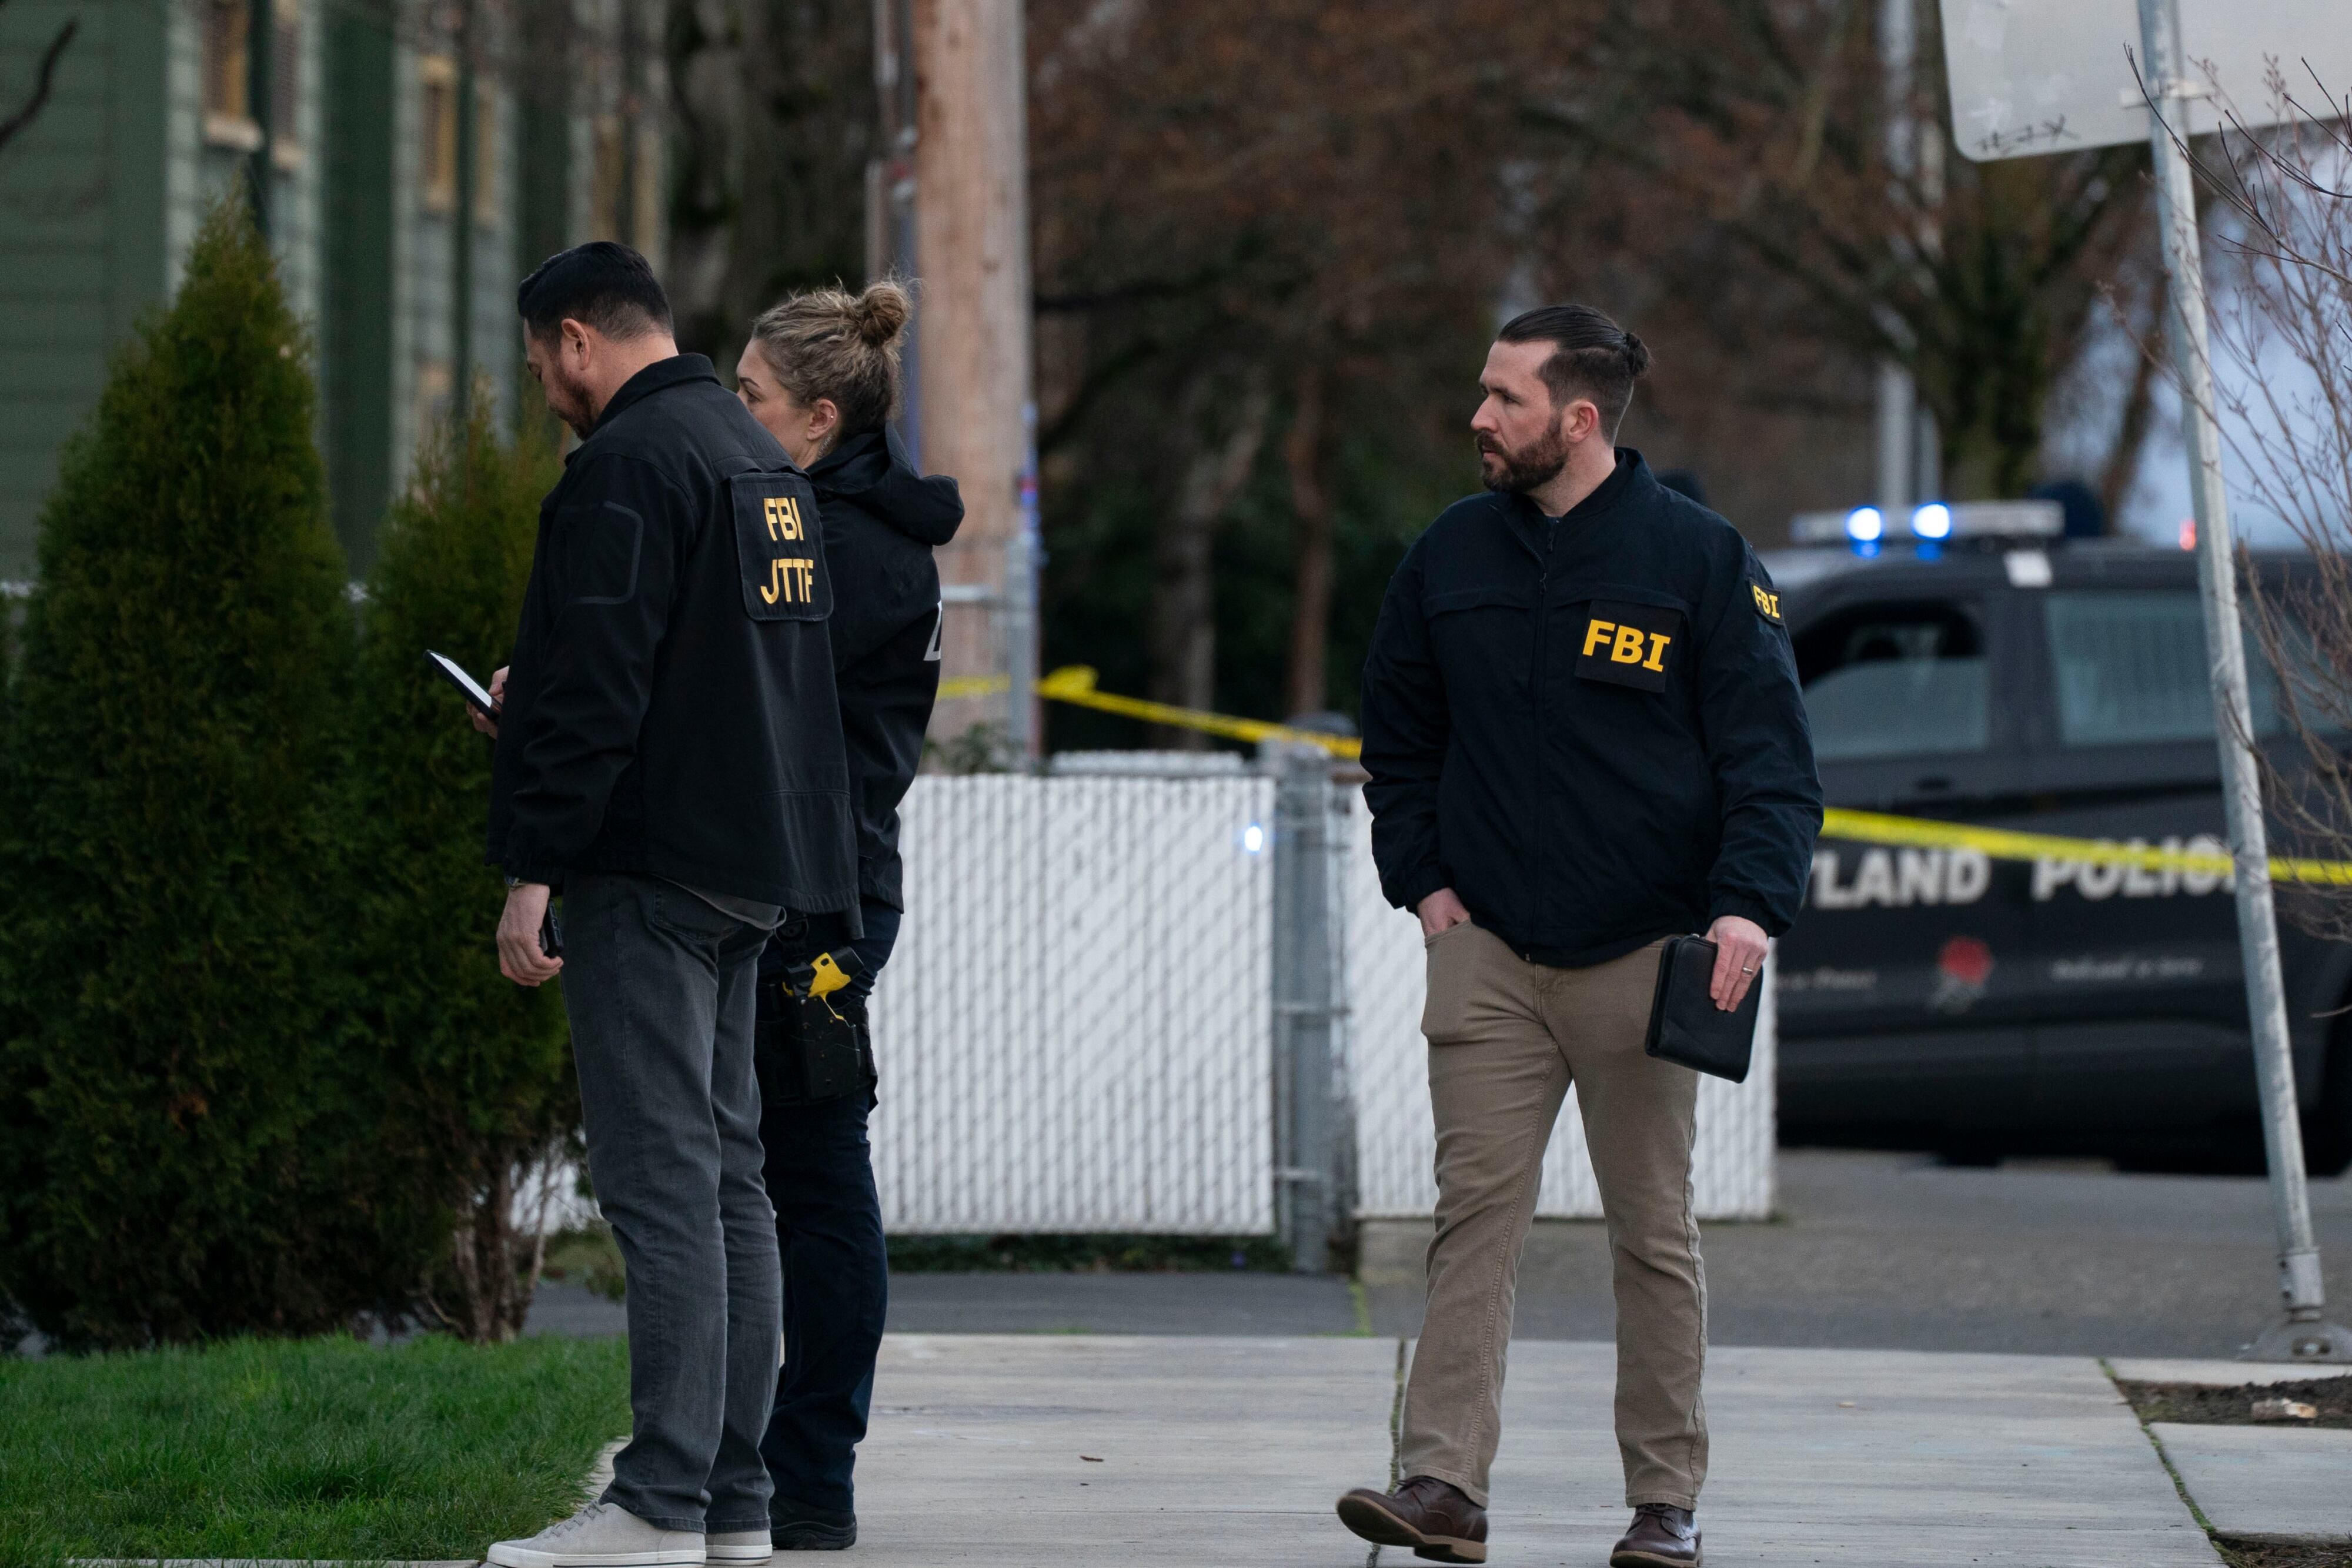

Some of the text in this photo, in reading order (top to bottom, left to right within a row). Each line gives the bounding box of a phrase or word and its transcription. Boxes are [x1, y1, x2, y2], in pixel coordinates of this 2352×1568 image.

[764, 497, 804, 541] FBI
[760, 559, 814, 604] JTTF
[1753, 585, 1780, 618] FBI
[1582, 619, 1671, 673] FBI
[1809, 833, 2236, 908] LAND POLIC
